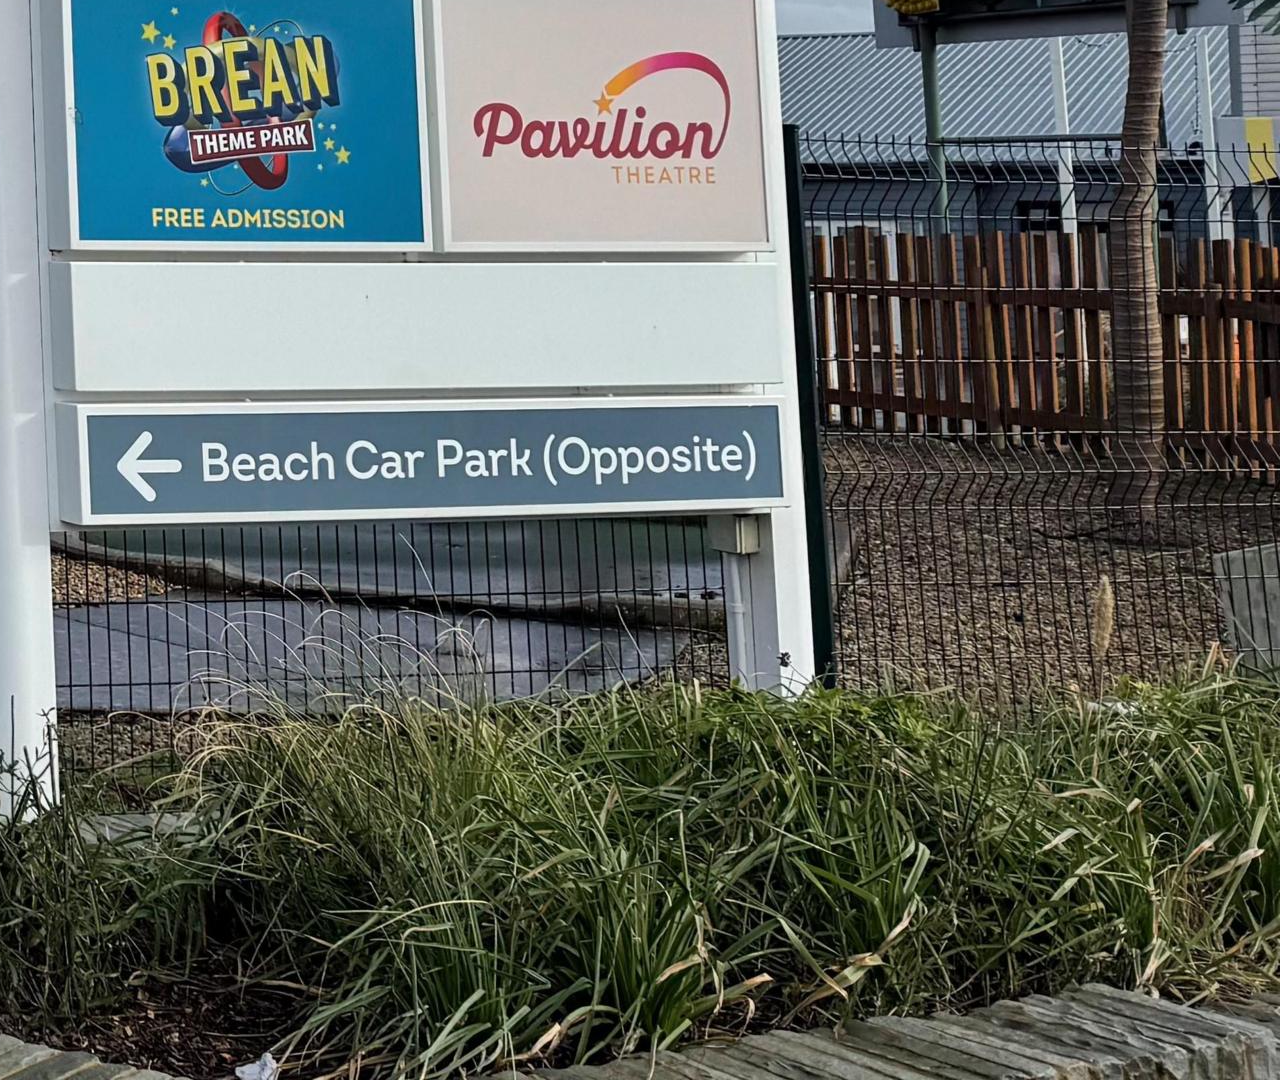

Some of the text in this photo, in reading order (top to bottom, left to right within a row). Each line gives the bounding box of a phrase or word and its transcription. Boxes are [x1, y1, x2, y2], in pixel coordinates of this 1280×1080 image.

[147, 35, 338, 124] BREAN
[193, 124, 308, 155] THEME PARK
[473, 101, 717, 160] Pavilion
[611, 165, 717, 185] THEATRE
[151, 207, 345, 229] FREE ADMISSION
[201, 430, 756, 487] Beach Car Park (Opposite)
